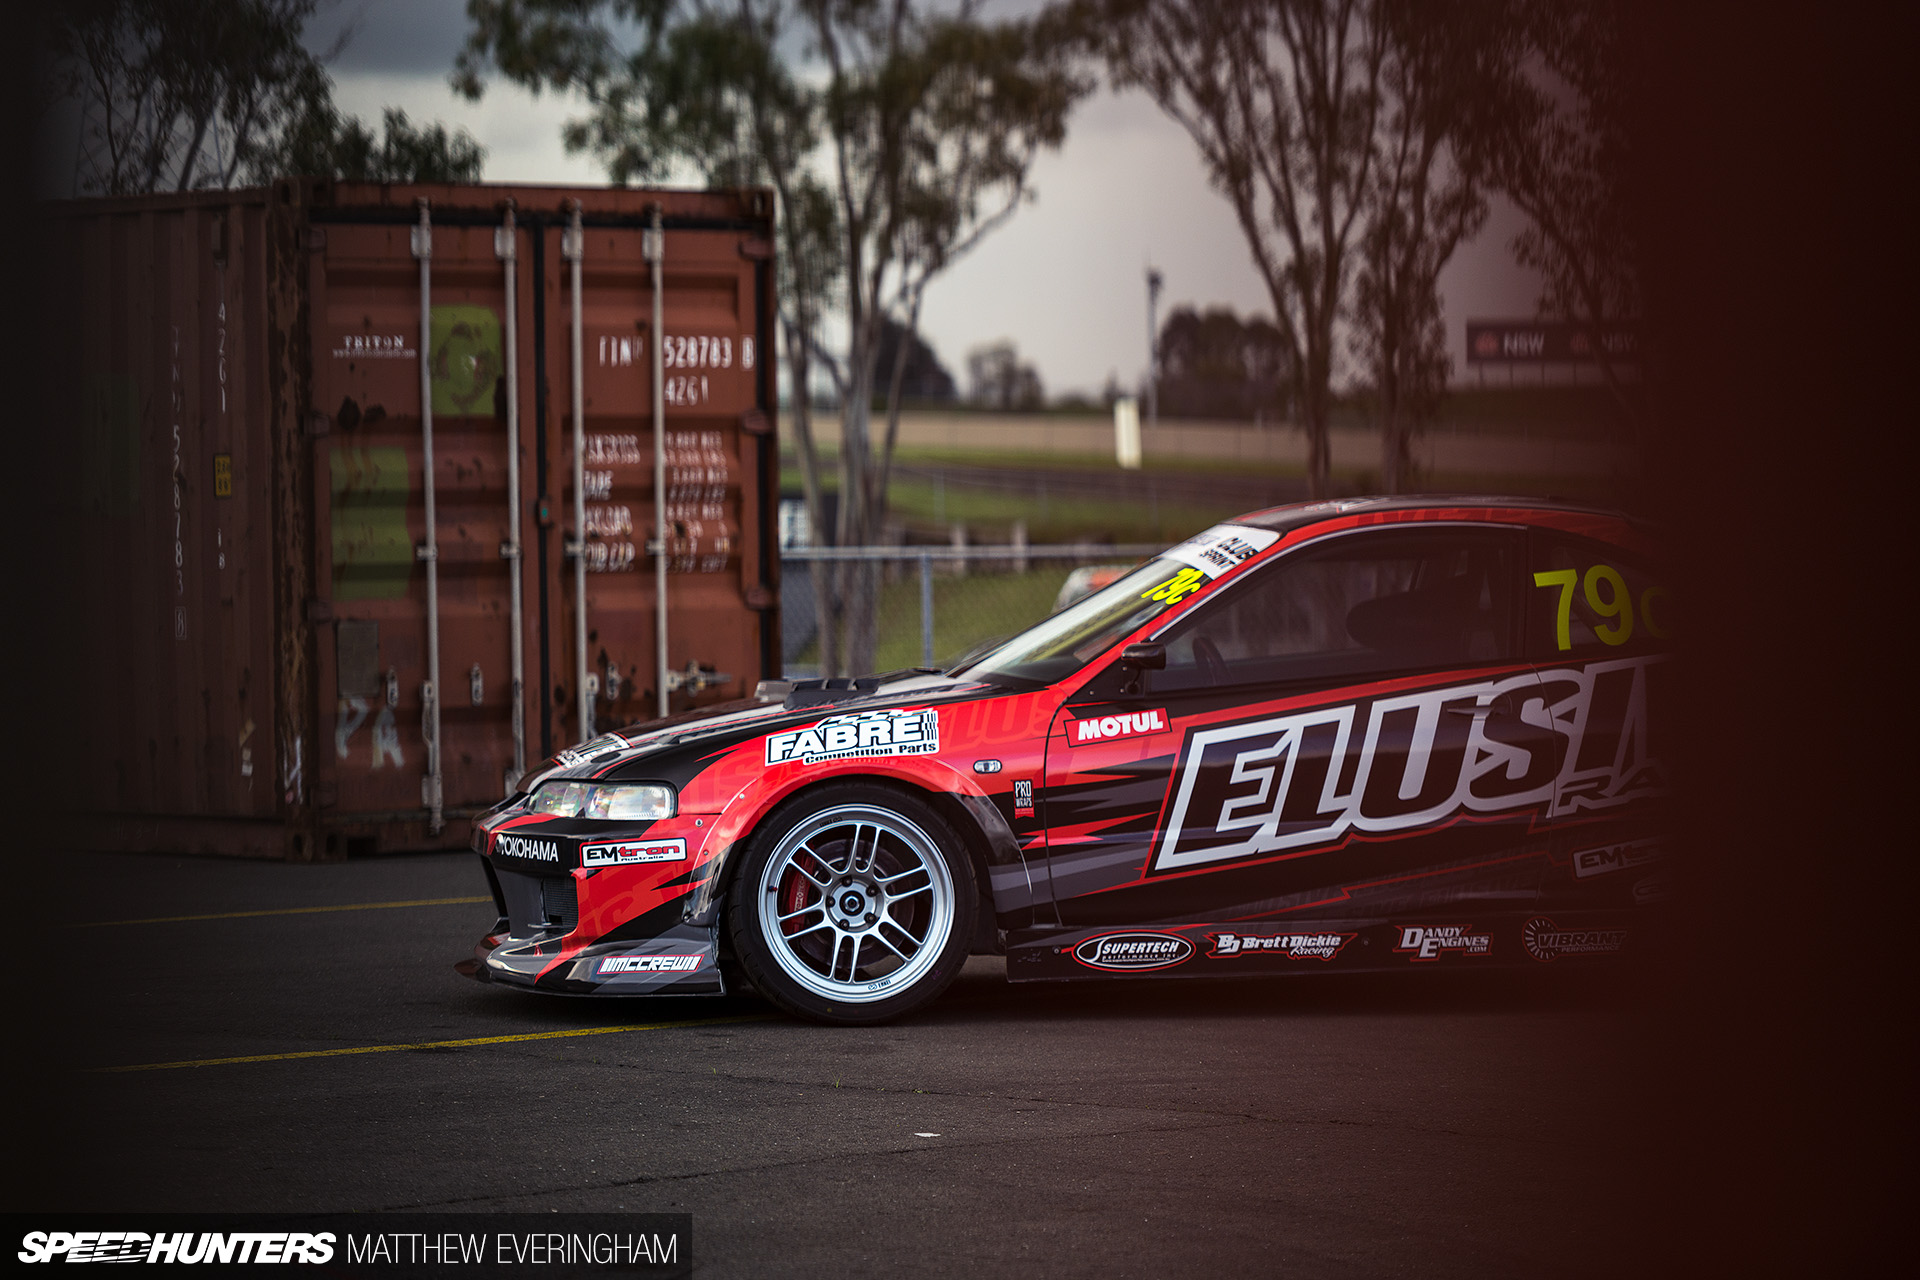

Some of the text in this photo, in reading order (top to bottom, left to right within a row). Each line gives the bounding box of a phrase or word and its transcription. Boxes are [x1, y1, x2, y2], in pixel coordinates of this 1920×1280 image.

[343, 335, 405, 350] TRITON
[663, 336, 732, 368] 528783
[1199, 548, 1237, 569] SPRINT
[1078, 711, 1164, 741] MOTUL
[768, 714, 925, 763] FABRE
[805, 743, 937, 764] Competition Parts
[1015, 780, 1032, 798] PRO
[586, 846, 680, 862] EMtron
[1102, 941, 1180, 955] SUPERTECH
[1242, 936, 1289, 949] Brett
[1289, 934, 1342, 947] Dickie
[1401, 927, 1465, 949] DANDY
[1419, 935, 1489, 958] ENGINES
[1537, 930, 1628, 949] VIBRANT
[1290, 946, 1335, 958] Racing
